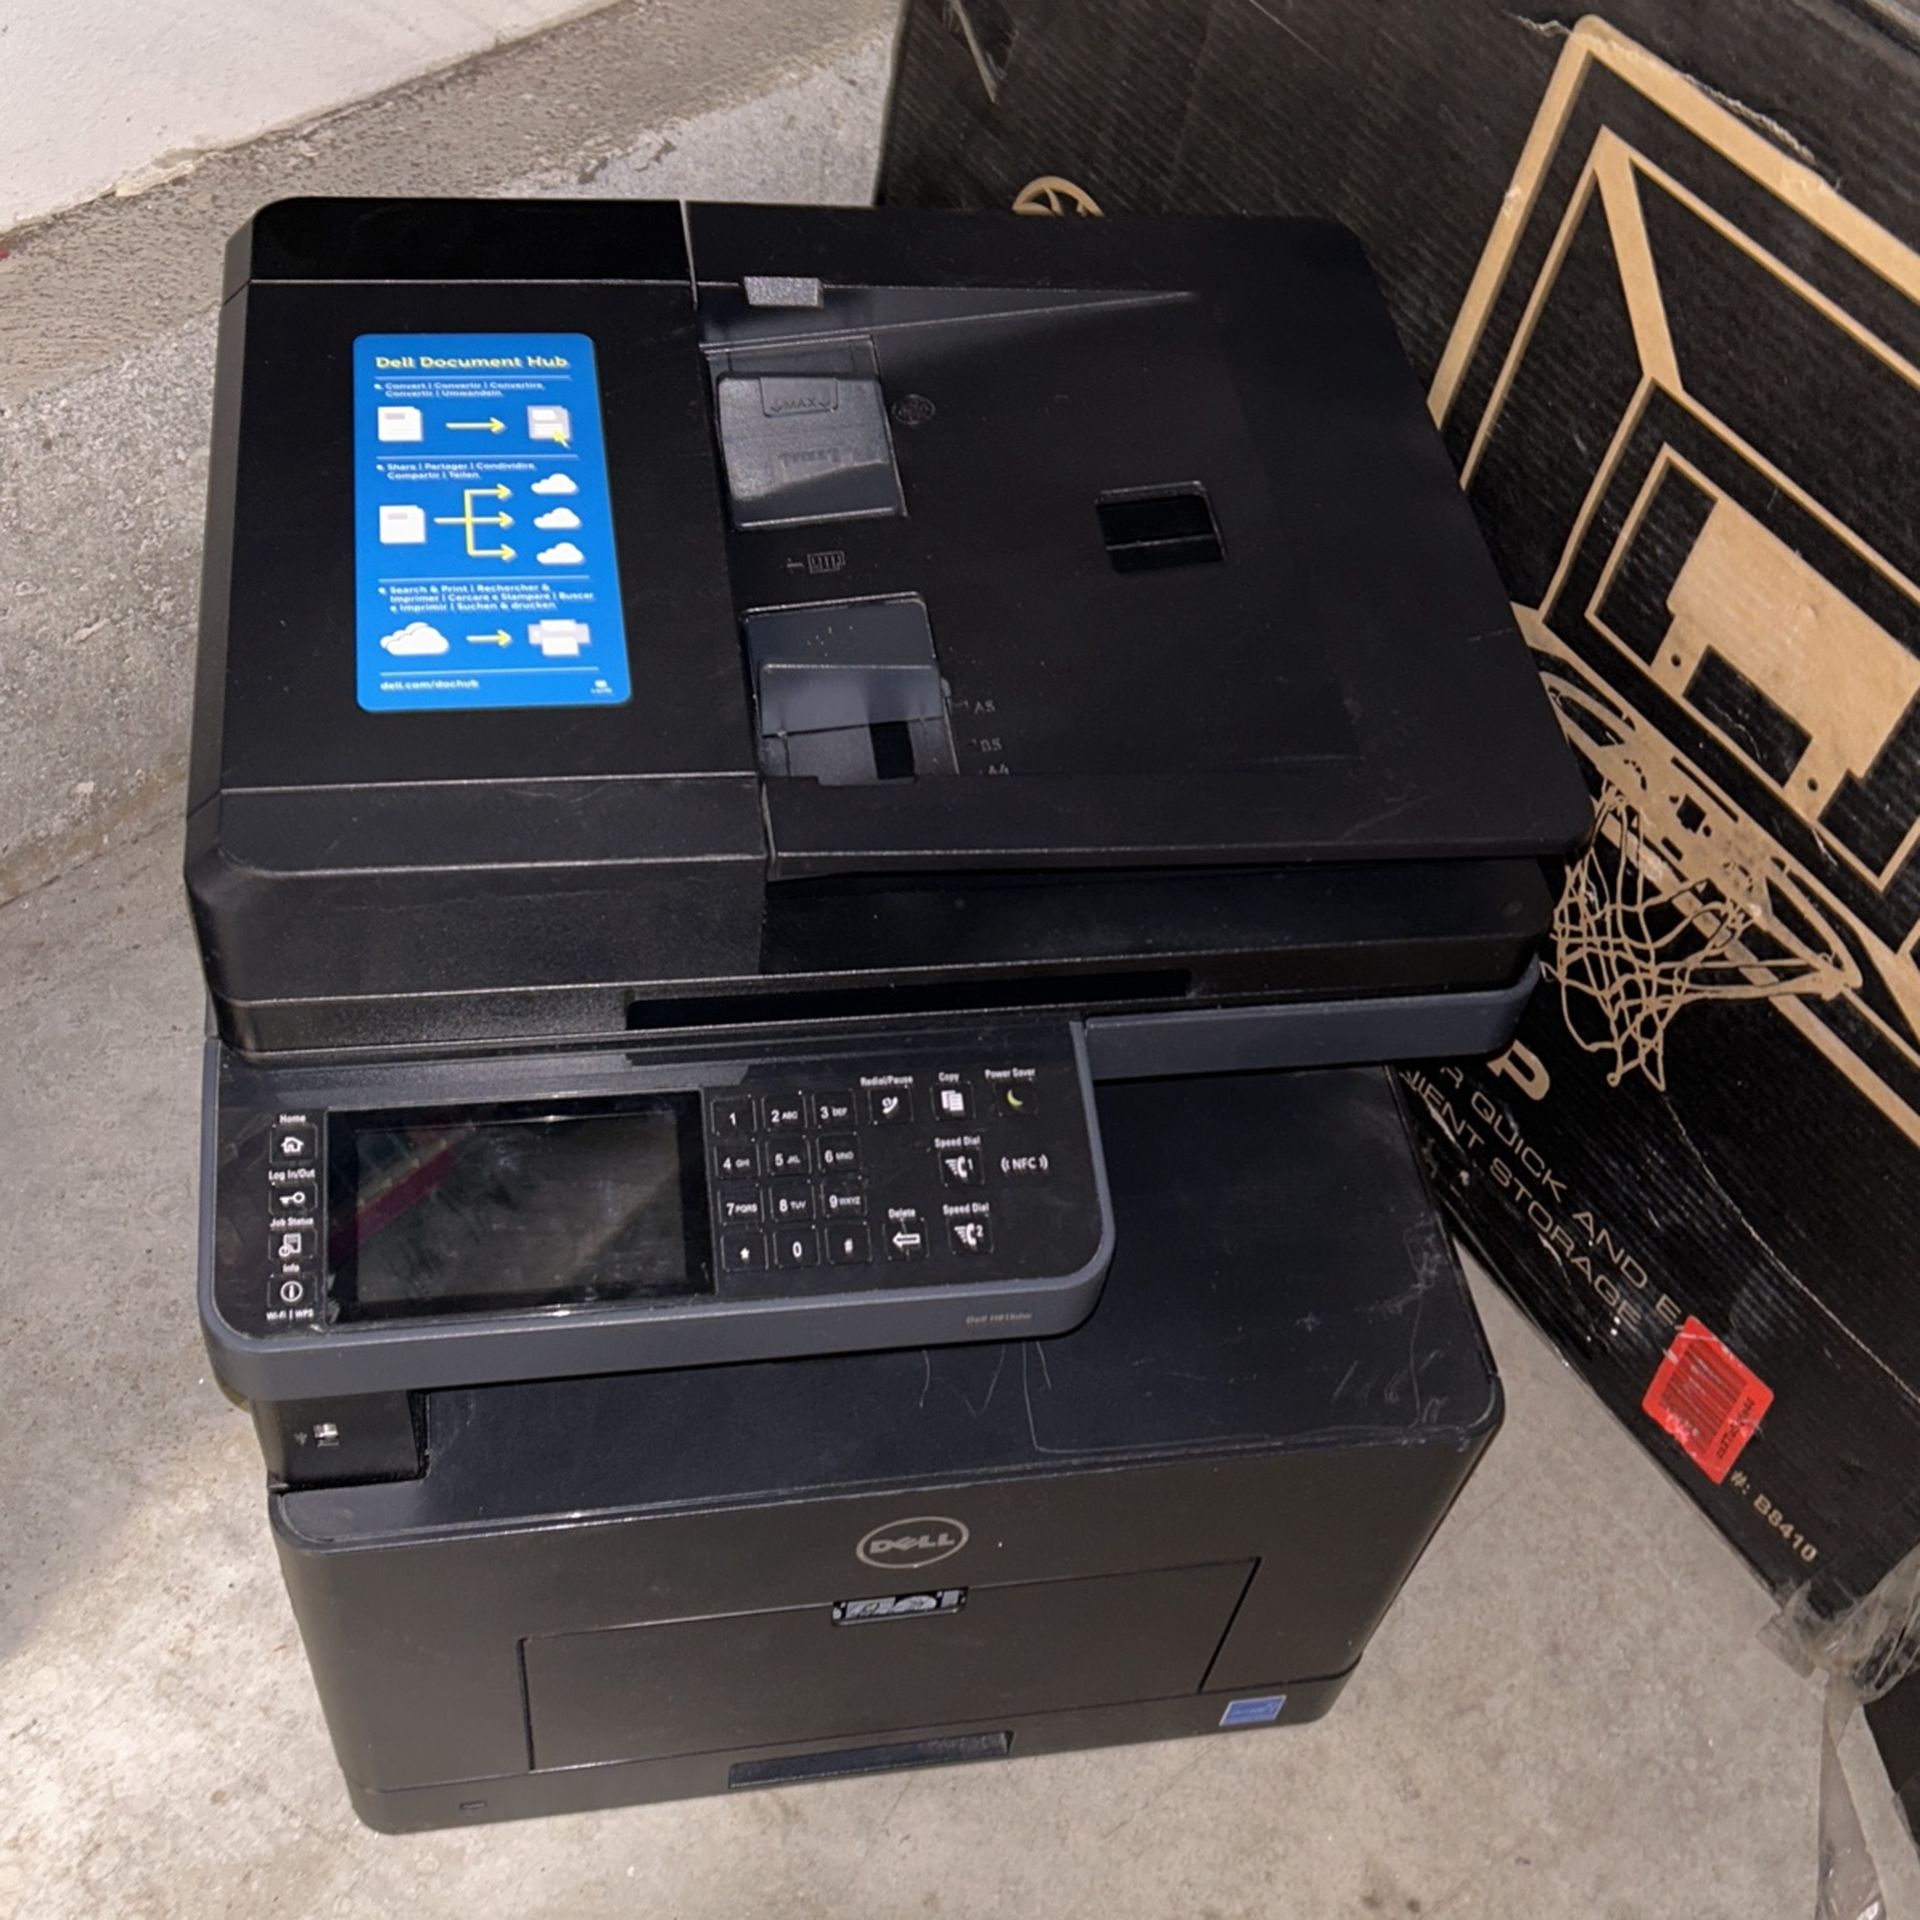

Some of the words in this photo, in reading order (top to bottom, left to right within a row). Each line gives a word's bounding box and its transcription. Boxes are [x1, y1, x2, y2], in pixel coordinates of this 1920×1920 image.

[376, 356, 416, 369] Dell
[420, 356, 523, 369] Document
[526, 355, 570, 369] Hub
[783, 398, 817, 410] MAX
[387, 463, 417, 472] Share
[390, 586, 428, 594] Search
[441, 584, 467, 593] Print
[477, 584, 539, 593] Rechercher
[448, 593, 490, 602] Cercare
[501, 592, 551, 602] Stampare
[457, 602, 498, 611] Suchen
[511, 601, 556, 611] drucken
[380, 679, 479, 691] dell.com/dochub
[938, 1071, 960, 1084] Copy
[985, 1069, 1009, 1080] Power
[1012, 1067, 1036, 1078] Saver
[860, 1074, 914, 1087] Redial/Pause
[279, 1114, 306, 1124] Home
[729, 1113, 737, 1126] 1
[771, 1109, 780, 1122] 2
[820, 1106, 829, 1120] 3
[934, 1136, 961, 1148] Speed
[963, 1135, 981, 1147] Dial
[775, 1153, 784, 1166] 5
[825, 1150, 834, 1163] 6
[723, 1157, 732, 1170] 4
[1013, 1157, 1037, 1171] NFC
[268, 1169, 286, 1182] Log
[287, 1168, 316, 1180] In/Out
[1471, 1091, 1568, 1203] QUICK
[1572, 1210, 1648, 1289] AND
[779, 1198, 788, 1212] 8
[829, 1194, 838, 1208] 9
[726, 1202, 735, 1216] 7
[888, 1207, 916, 1219] Delete
[943, 1204, 969, 1216] Speed
[971, 1202, 990, 1214] Dial
[270, 1218, 287, 1229] Job
[287, 1216, 314, 1228] Status
[1489, 1157, 1642, 1327] STORAGE
[793, 1241, 802, 1259] 0
[283, 1264, 300, 1274] Info
[295, 1308, 315, 1320] WPS
[1753, 1494, 1818, 1562] B8410
[869, 1532, 956, 1555] DELL
